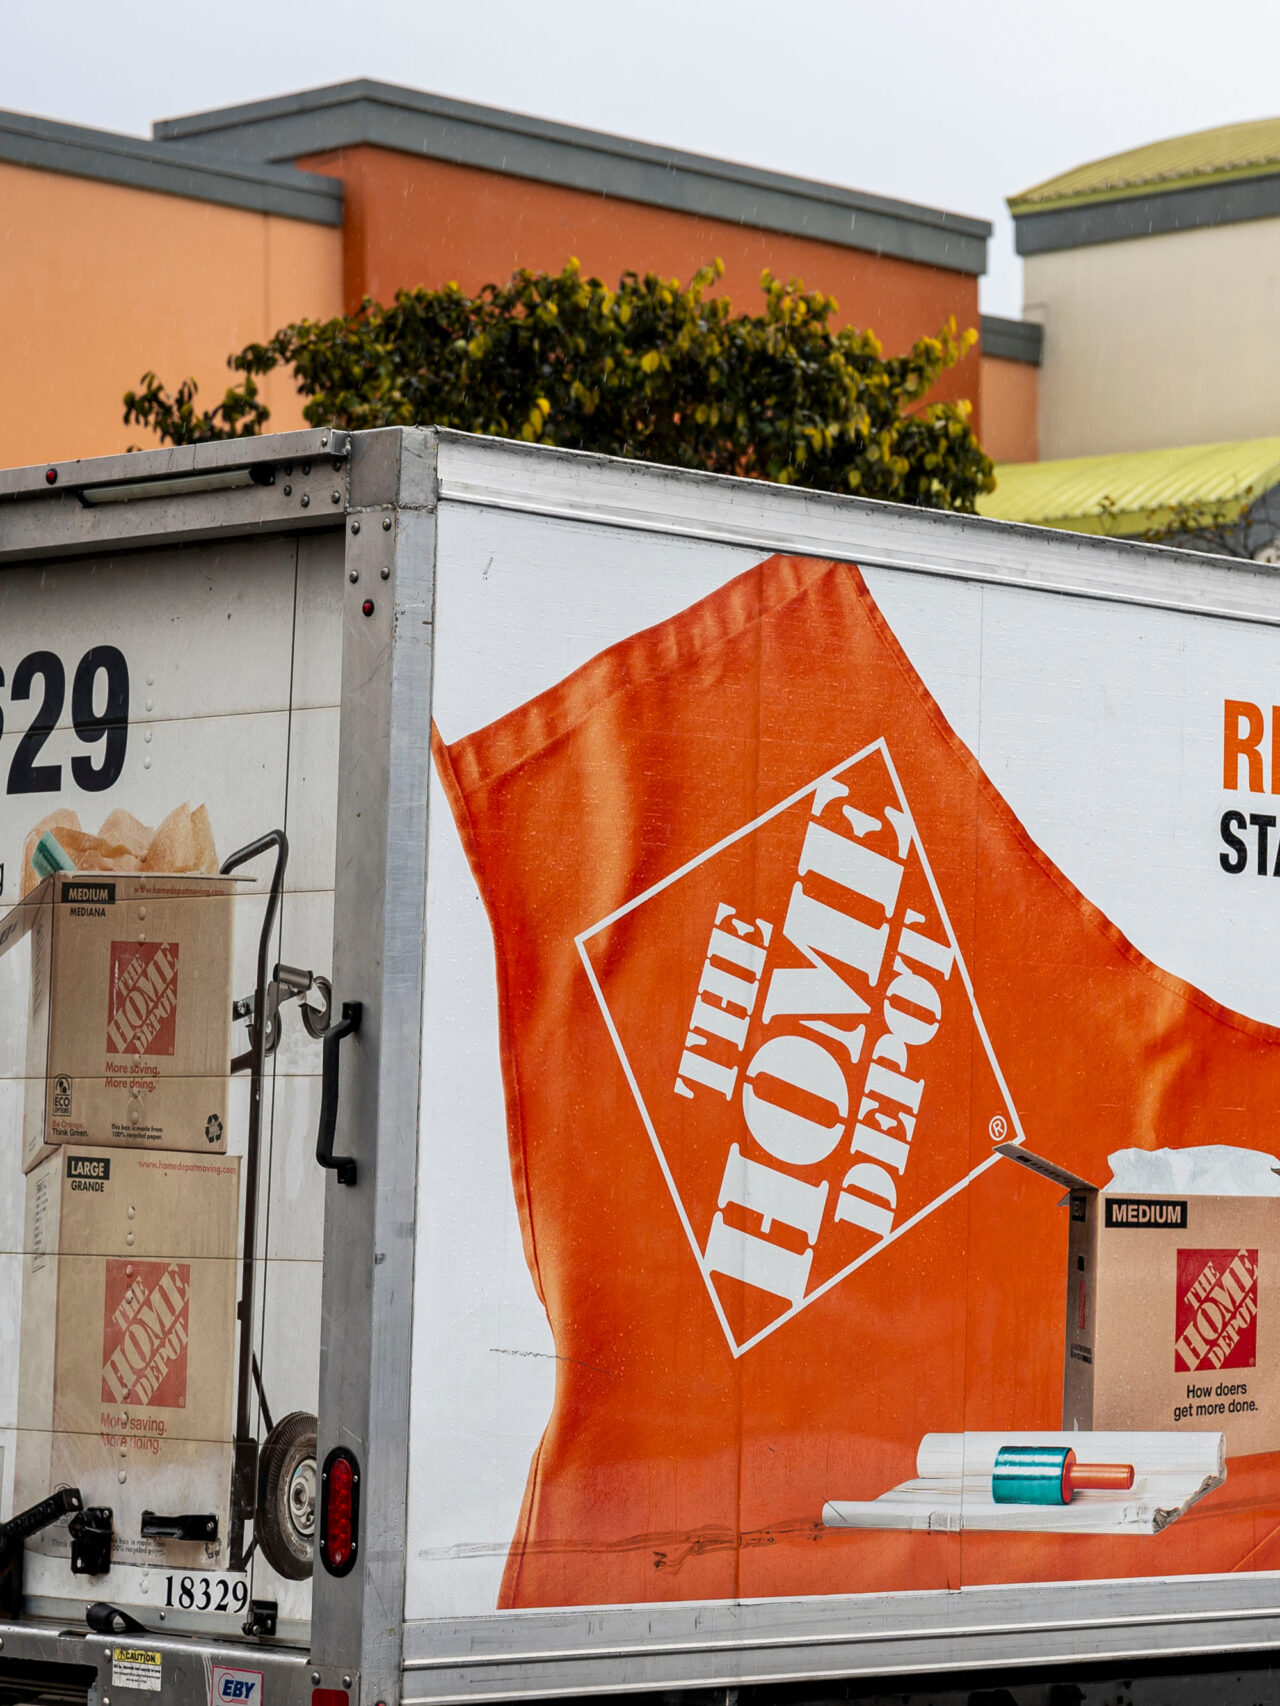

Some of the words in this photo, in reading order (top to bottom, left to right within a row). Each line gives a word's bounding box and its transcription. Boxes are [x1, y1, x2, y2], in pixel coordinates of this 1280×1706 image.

[0, 645, 130, 795] 29
[68, 887, 109, 901] MEDIUM
[69, 907, 106, 918] MEDIANA
[116, 953, 146, 998] THE
[107, 942, 179, 1055] HOME
[673, 901, 774, 1102] THE
[132, 984, 178, 1055] DEPOT
[702, 778, 913, 1310] HOME
[104, 1061, 129, 1074] More
[130, 1062, 160, 1078] saving.
[833, 907, 957, 1240] DEPOT
[104, 1076, 128, 1089] More
[129, 1076, 156, 1093] doing.
[54, 1096, 70, 1107] ECO
[52, 1119, 60, 1128] Be
[52, 1127, 68, 1136] Think
[69, 1128, 89, 1137] Green.
[71, 1160, 105, 1177] LARGE
[138, 1160, 237, 1176] www.homedepotmoving.com
[71, 1180, 105, 1192] GRANDE
[1111, 1203, 1182, 1224] MEDIUM
[1184, 1260, 1220, 1311] THE
[112, 1275, 149, 1332] THE
[1174, 1248, 1259, 1372] HOME
[101, 1262, 190, 1404] HOME
[1206, 1292, 1258, 1370] DEPOT
[134, 1316, 189, 1406] DEPOT
[1186, 1384, 1212, 1400] How
[1215, 1382, 1247, 1397] doers
[1173, 1403, 1193, 1421] get
[1195, 1402, 1226, 1416] more
[1228, 1398, 1259, 1414] done.
[101, 1412, 128, 1430] More
[129, 1415, 168, 1436] saving.
[165, 1575, 248, 1613] 18329
[125, 1651, 156, 1664] CAUTION
[222, 1679, 256, 1699] EBY
